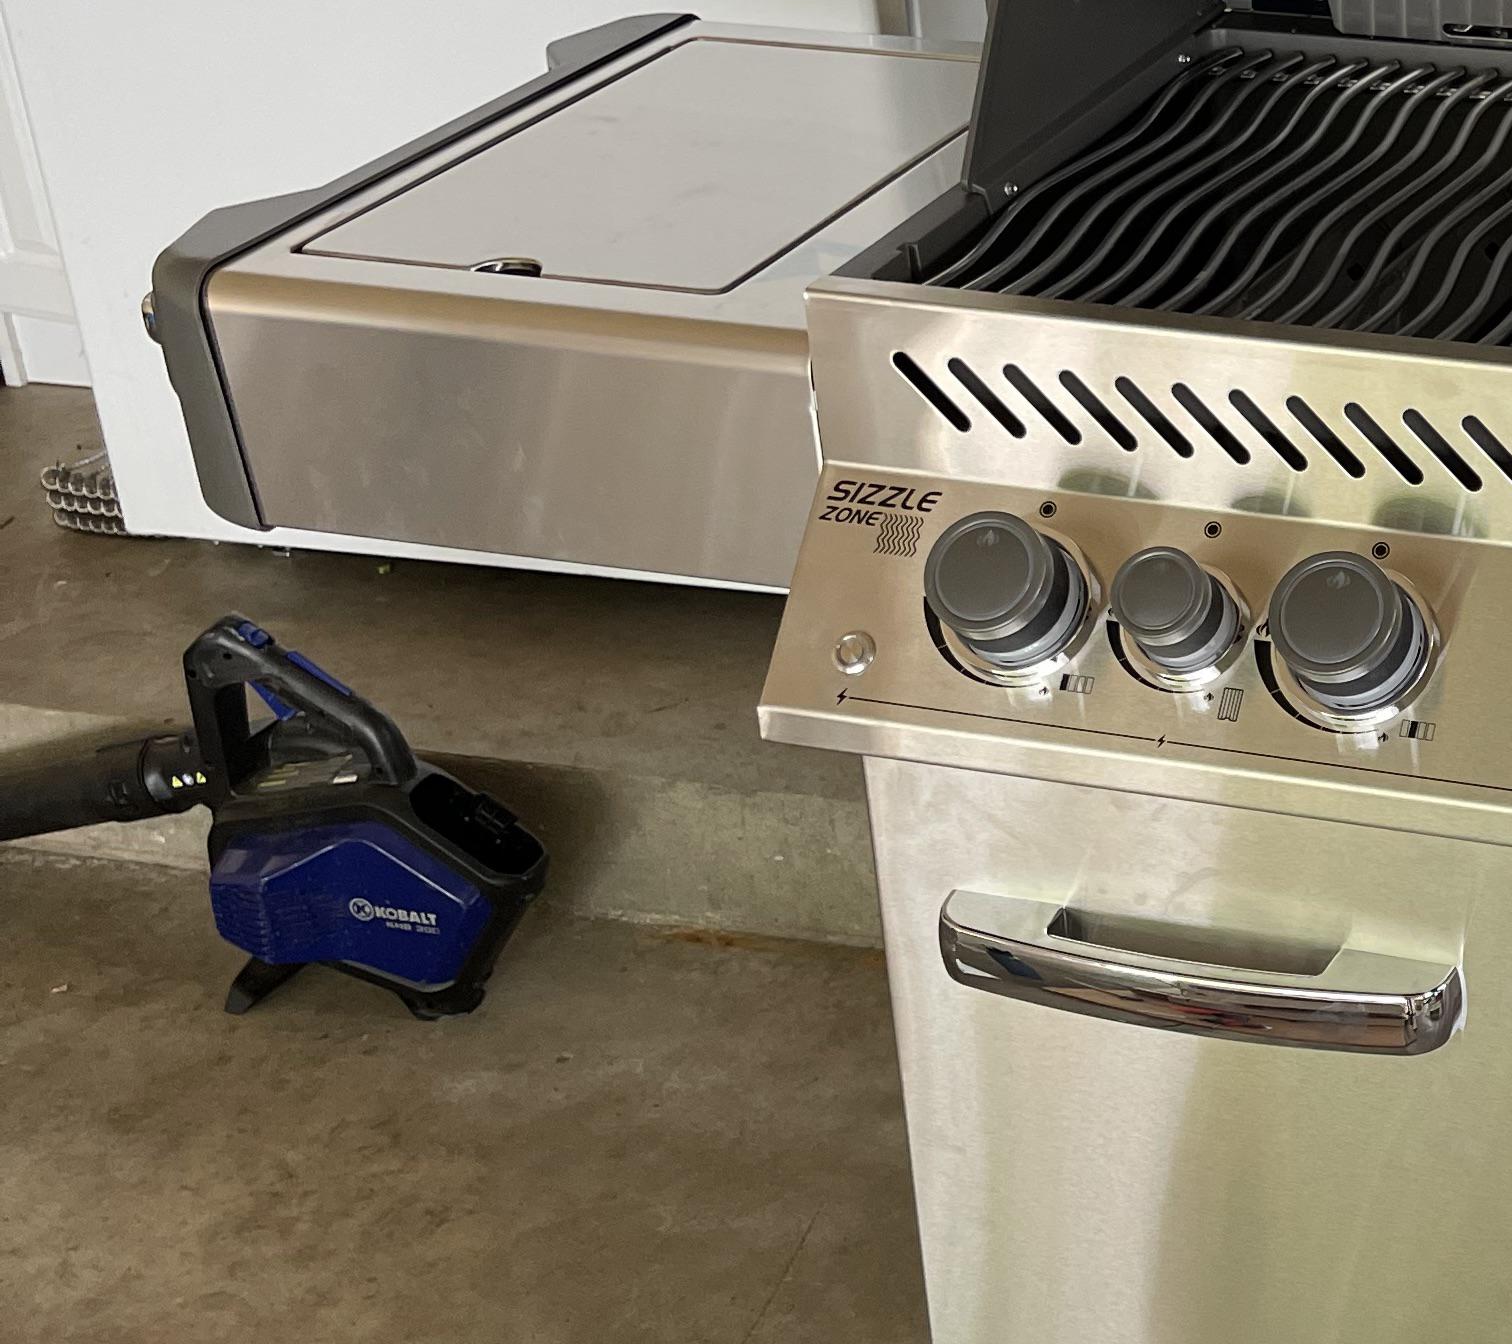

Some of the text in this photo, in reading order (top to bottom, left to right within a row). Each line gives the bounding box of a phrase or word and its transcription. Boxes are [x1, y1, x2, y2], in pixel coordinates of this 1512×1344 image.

[827, 479, 943, 513] SIZZLE
[818, 505, 885, 527] ZONE
[374, 905, 437, 926] KOBALT
